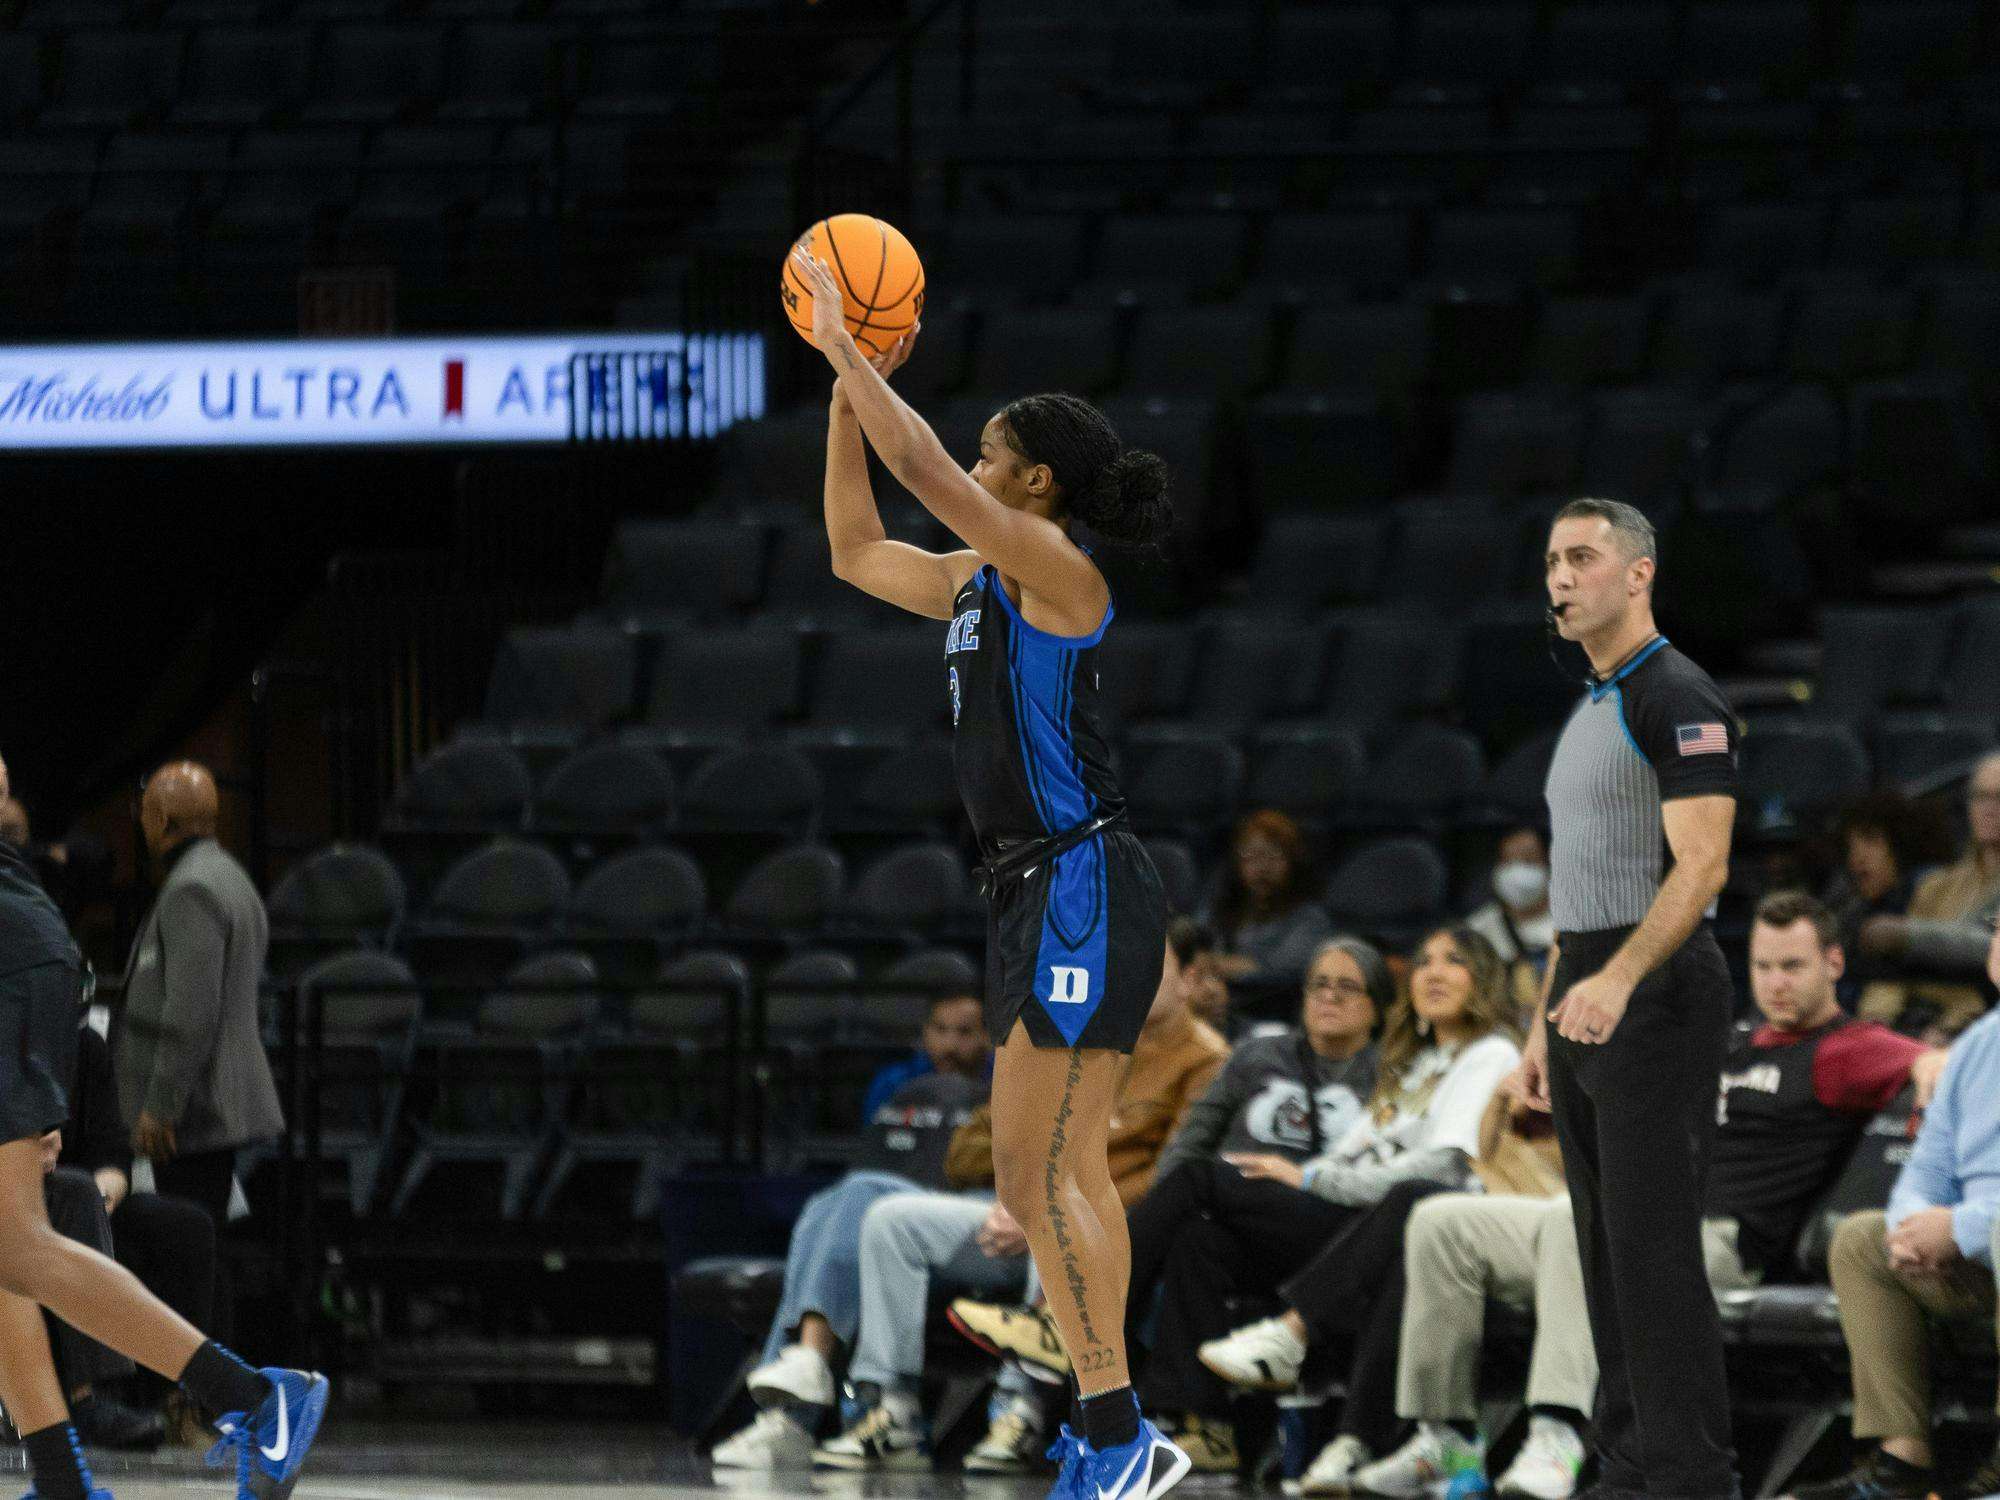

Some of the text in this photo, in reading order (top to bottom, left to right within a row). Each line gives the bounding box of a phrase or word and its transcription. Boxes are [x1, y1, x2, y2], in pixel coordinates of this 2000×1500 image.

[201, 367, 409, 419] ULTRA
[1048, 965, 1089, 1004] D
[1079, 1347, 1117, 1373] 222
